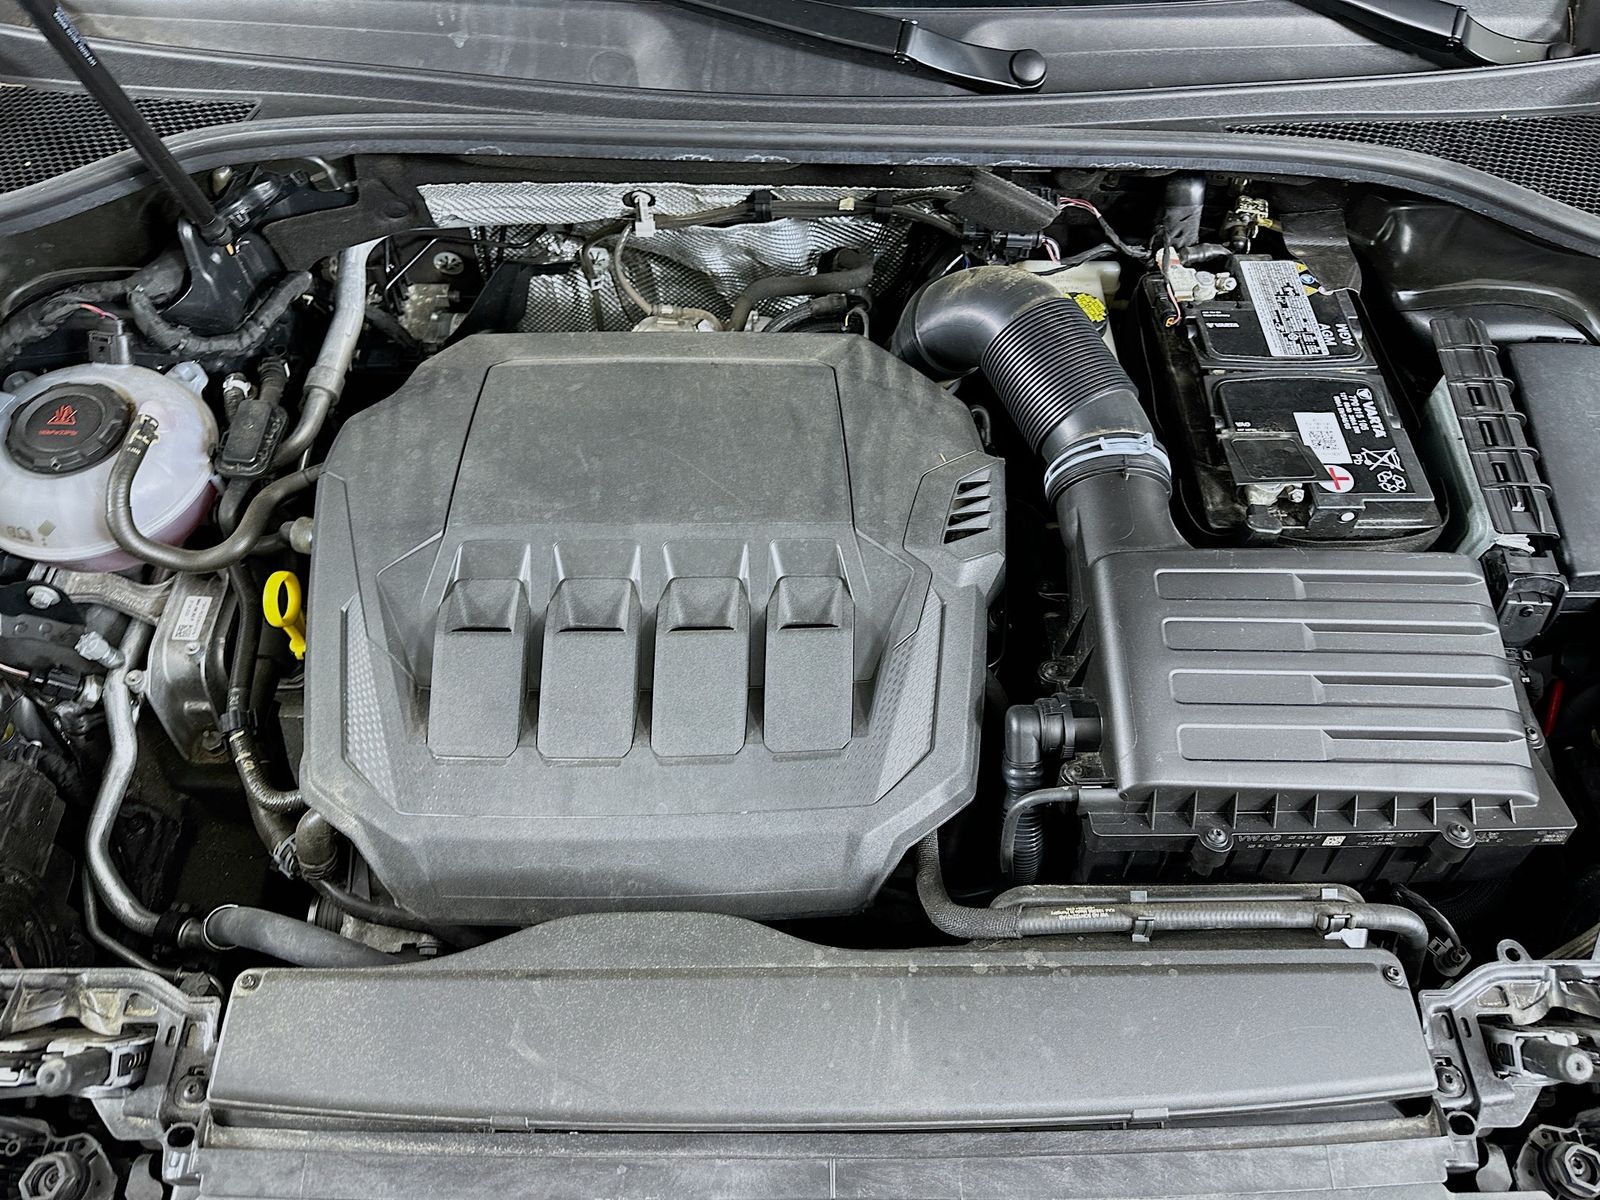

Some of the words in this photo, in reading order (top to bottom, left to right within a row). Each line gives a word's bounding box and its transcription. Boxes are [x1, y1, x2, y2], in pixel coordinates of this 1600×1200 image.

[1318, 323, 1338, 346] AGM
[1335, 323, 1355, 346] AGM
[1362, 400, 1387, 438] VARTA
[1351, 453, 1365, 467] Pb
[1238, 835, 1260, 843] VW
[1258, 834, 1282, 842] AG
